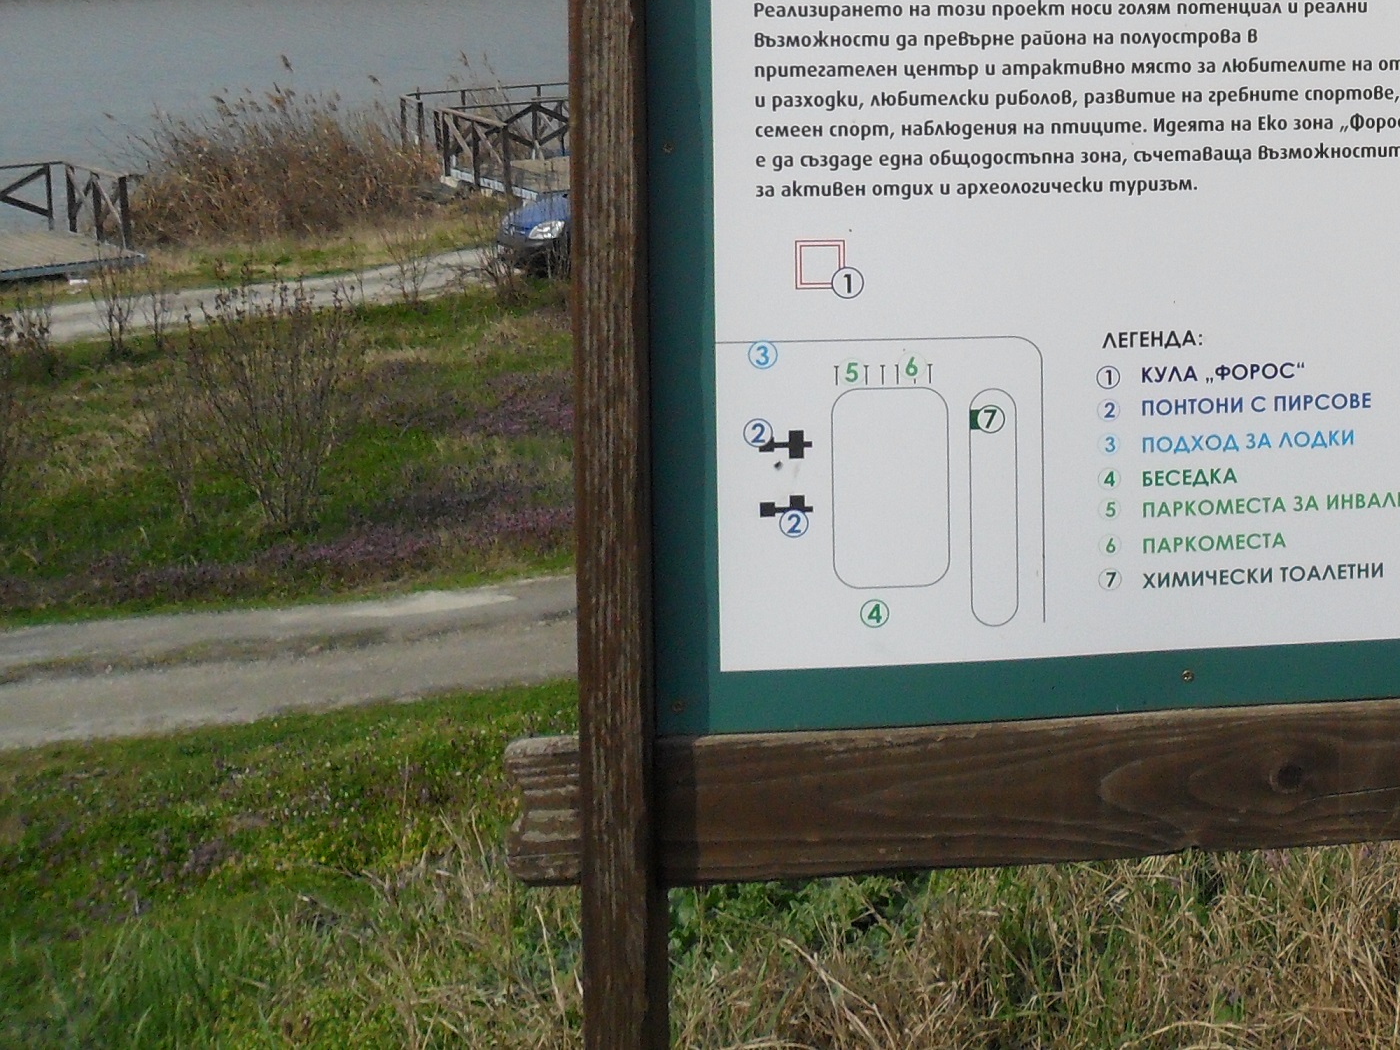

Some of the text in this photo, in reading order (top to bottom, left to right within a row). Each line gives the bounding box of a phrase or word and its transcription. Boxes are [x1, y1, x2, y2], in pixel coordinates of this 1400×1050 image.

[753, 0, 1368, 22] Реализирането на този проект носи голям потенциал и реални
[755, 155, 767, 168] е
[771, 155, 794, 172] да
[799, 154, 873, 172] създаде
[878, 153, 923, 171] една
[929, 149, 1075, 170] общодостъпна
[1080, 150, 1128, 167] зона,
[1133, 145, 1252, 164] съчетаваща
[755, 175, 1198, 201] за активен отдих и археологически туризъм.
[1101, 329, 1203, 350] ЛЕГЕНДА:
[1141, 365, 1199, 384] КУЛА
[1141, 396, 1244, 417] ПОНТОНИ
[1250, 395, 1267, 413] С
[1273, 392, 1372, 413] ПИРСОВЕ
[1141, 433, 1240, 455] ПОДХОД
[1245, 432, 1273, 450] ЗА
[1278, 429, 1355, 450] ЛОДКИ
[1142, 467, 1238, 488] БЕСЕДКА
[1142, 496, 1287, 519] ПАРКОМЕСТА
[1292, 495, 1319, 513] ЗА
[1142, 531, 1287, 555] ПАРКОМЕСТА
[1142, 567, 1273, 590] ХИМИЧЕСКИ
[1279, 561, 1384, 583] ТОАЛЕТНИ
